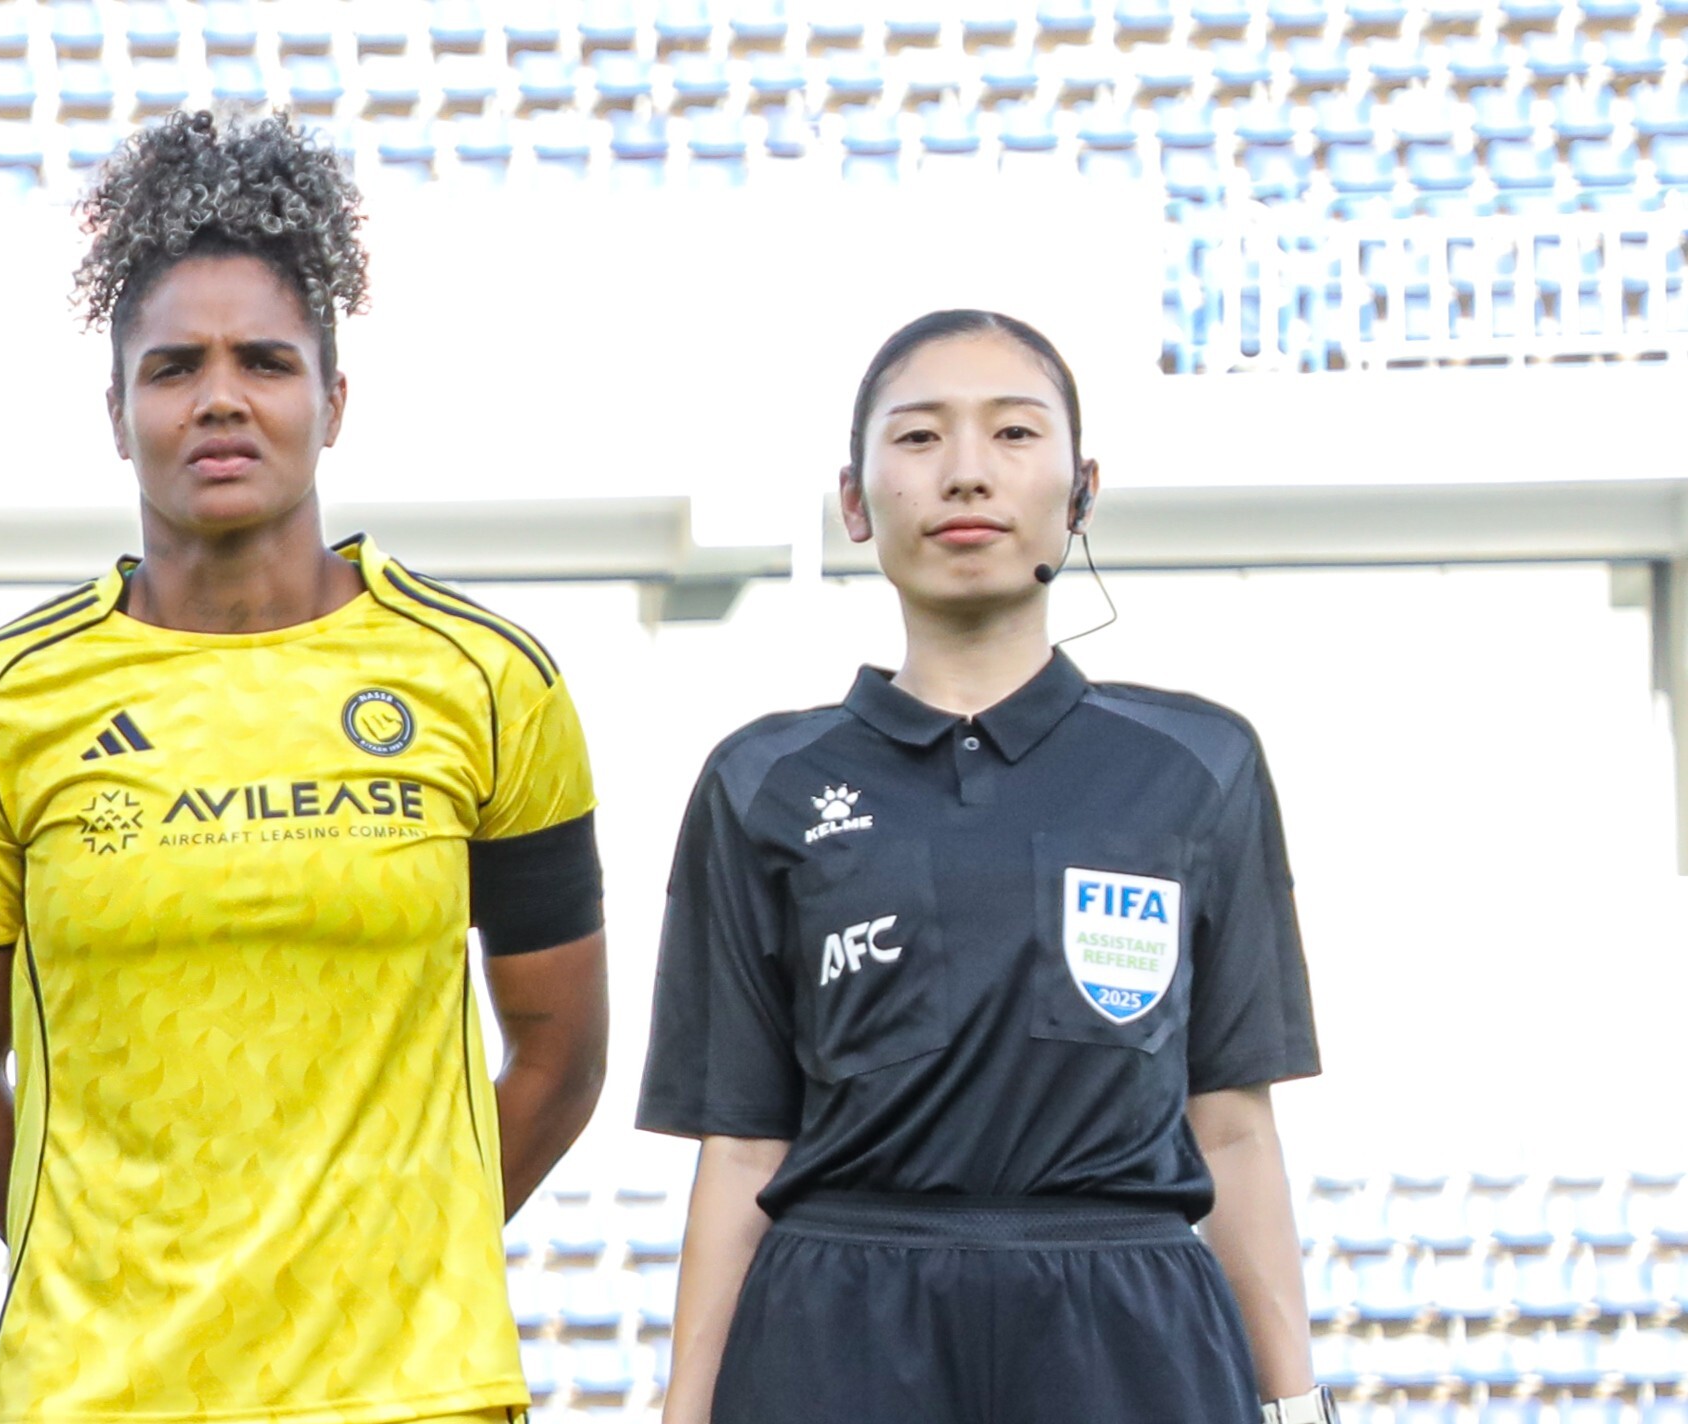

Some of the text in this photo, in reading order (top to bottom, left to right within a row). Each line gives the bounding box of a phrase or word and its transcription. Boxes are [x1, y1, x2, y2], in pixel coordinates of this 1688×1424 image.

[161, 780, 425, 823] AVILEASE
[159, 830, 253, 846] AIRCRAFT
[261, 827, 340, 842] LEASING
[805, 814, 873, 843] KELME
[1077, 880, 1169, 924] FIFA
[820, 914, 904, 987] AFC
[1077, 931, 1167, 955] ASSISTANT
[1083, 948, 1160, 973] REFEREE
[1098, 988, 1142, 1010] 2025
